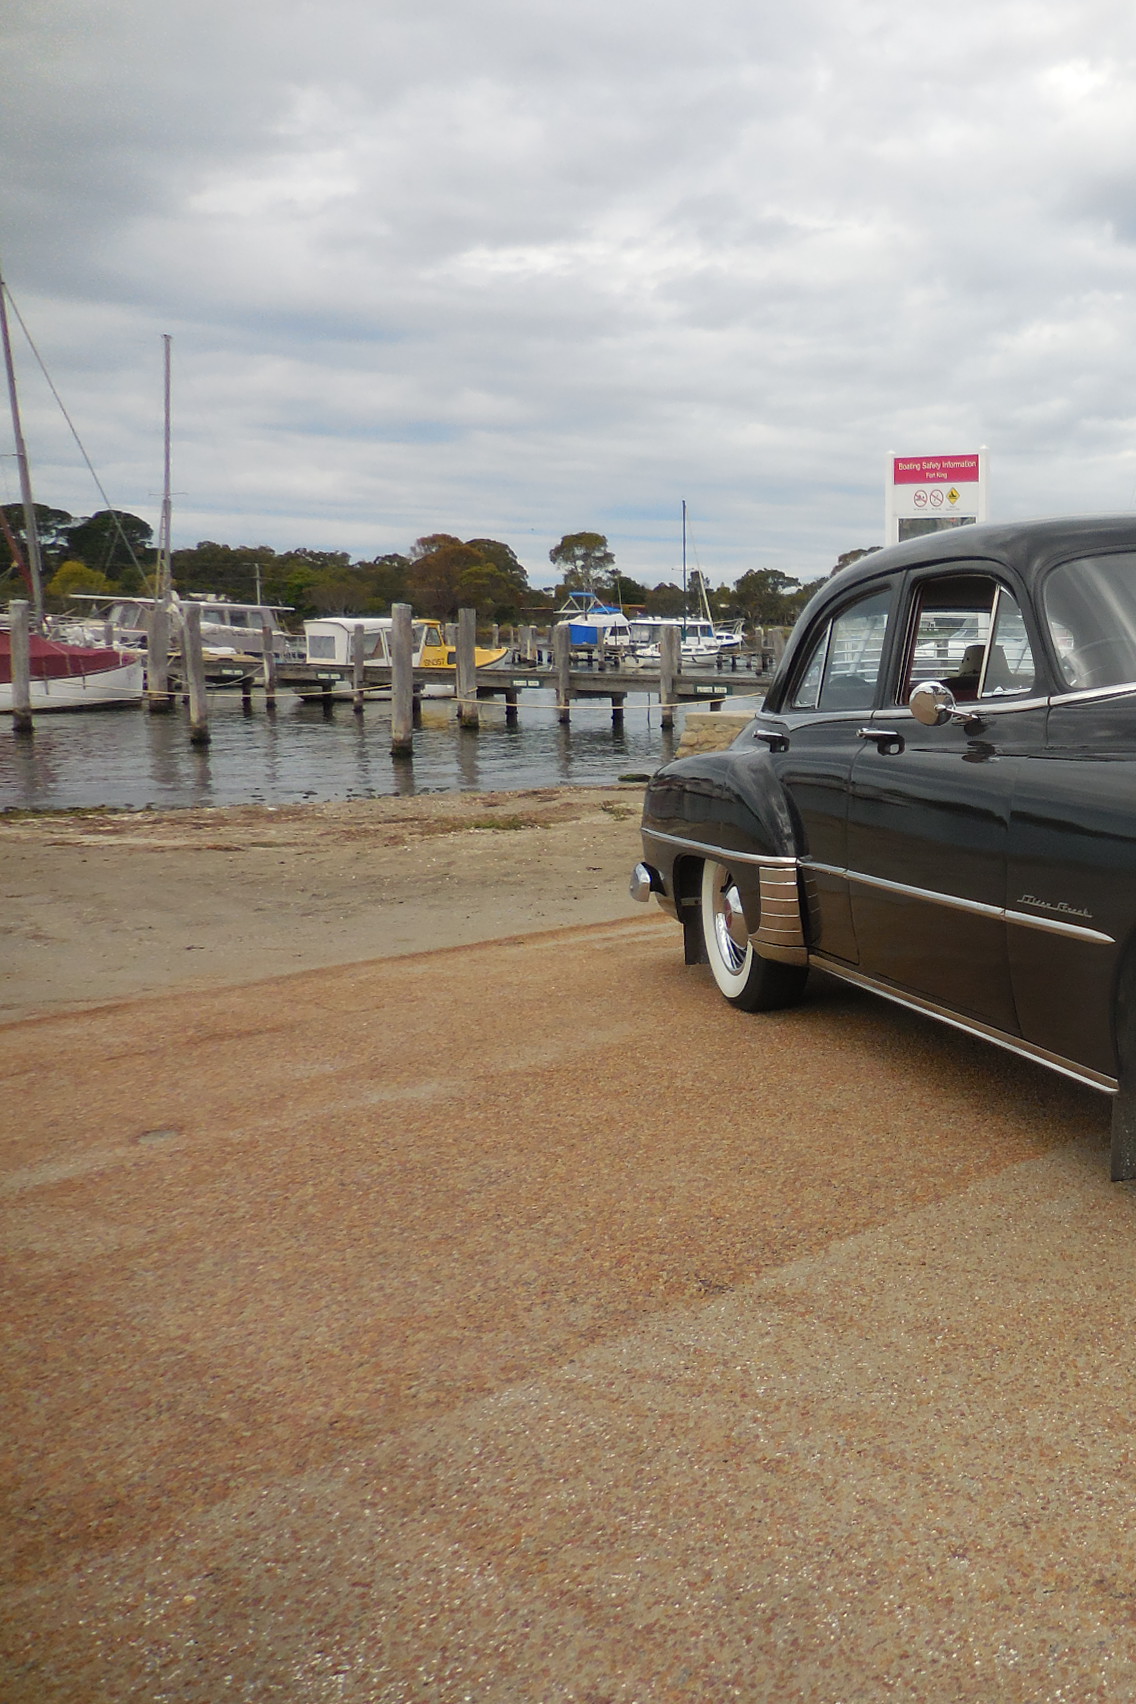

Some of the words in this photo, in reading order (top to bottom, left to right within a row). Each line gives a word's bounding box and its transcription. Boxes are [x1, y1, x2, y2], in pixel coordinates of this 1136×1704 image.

[898, 462, 921, 471] Boating
[922, 461, 942, 470] Safety
[942, 460, 977, 469] Information
